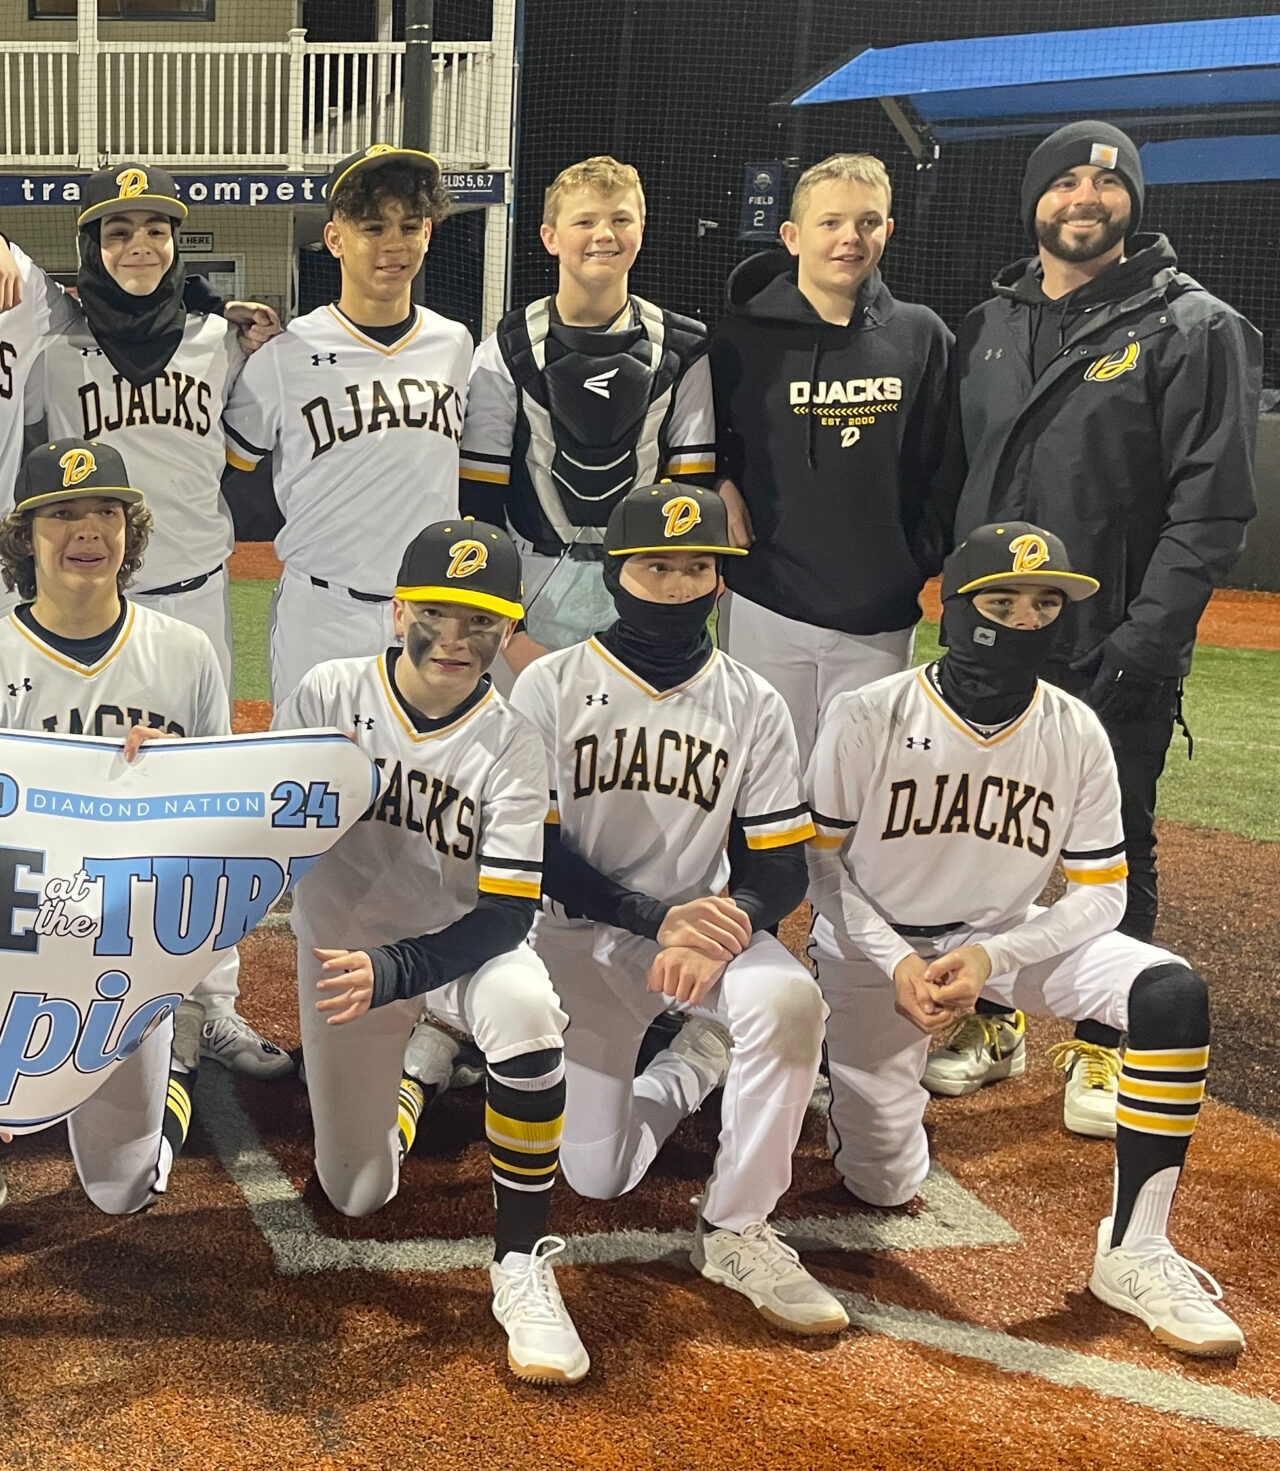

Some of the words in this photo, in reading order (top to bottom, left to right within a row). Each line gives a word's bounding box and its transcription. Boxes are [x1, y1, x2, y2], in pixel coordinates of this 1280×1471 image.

[22, 178, 80, 201] tra
[442, 175, 465, 187] ELDS
[748, 196, 774, 205] FIELD
[753, 210, 765, 227] 2
[186, 236, 211, 245] HERE
[790, 377, 902, 405] DJACKS
[572, 728, 729, 813] DJACKS
[33, 793, 149, 817] DIAMOND
[164, 793, 261, 815] NATION
[271, 780, 340, 828] 24
[880, 773, 1054, 858] DJACKS
[46, 870, 91, 903] at
[35, 898, 97, 940] the
[82, 856, 320, 957] TUR
